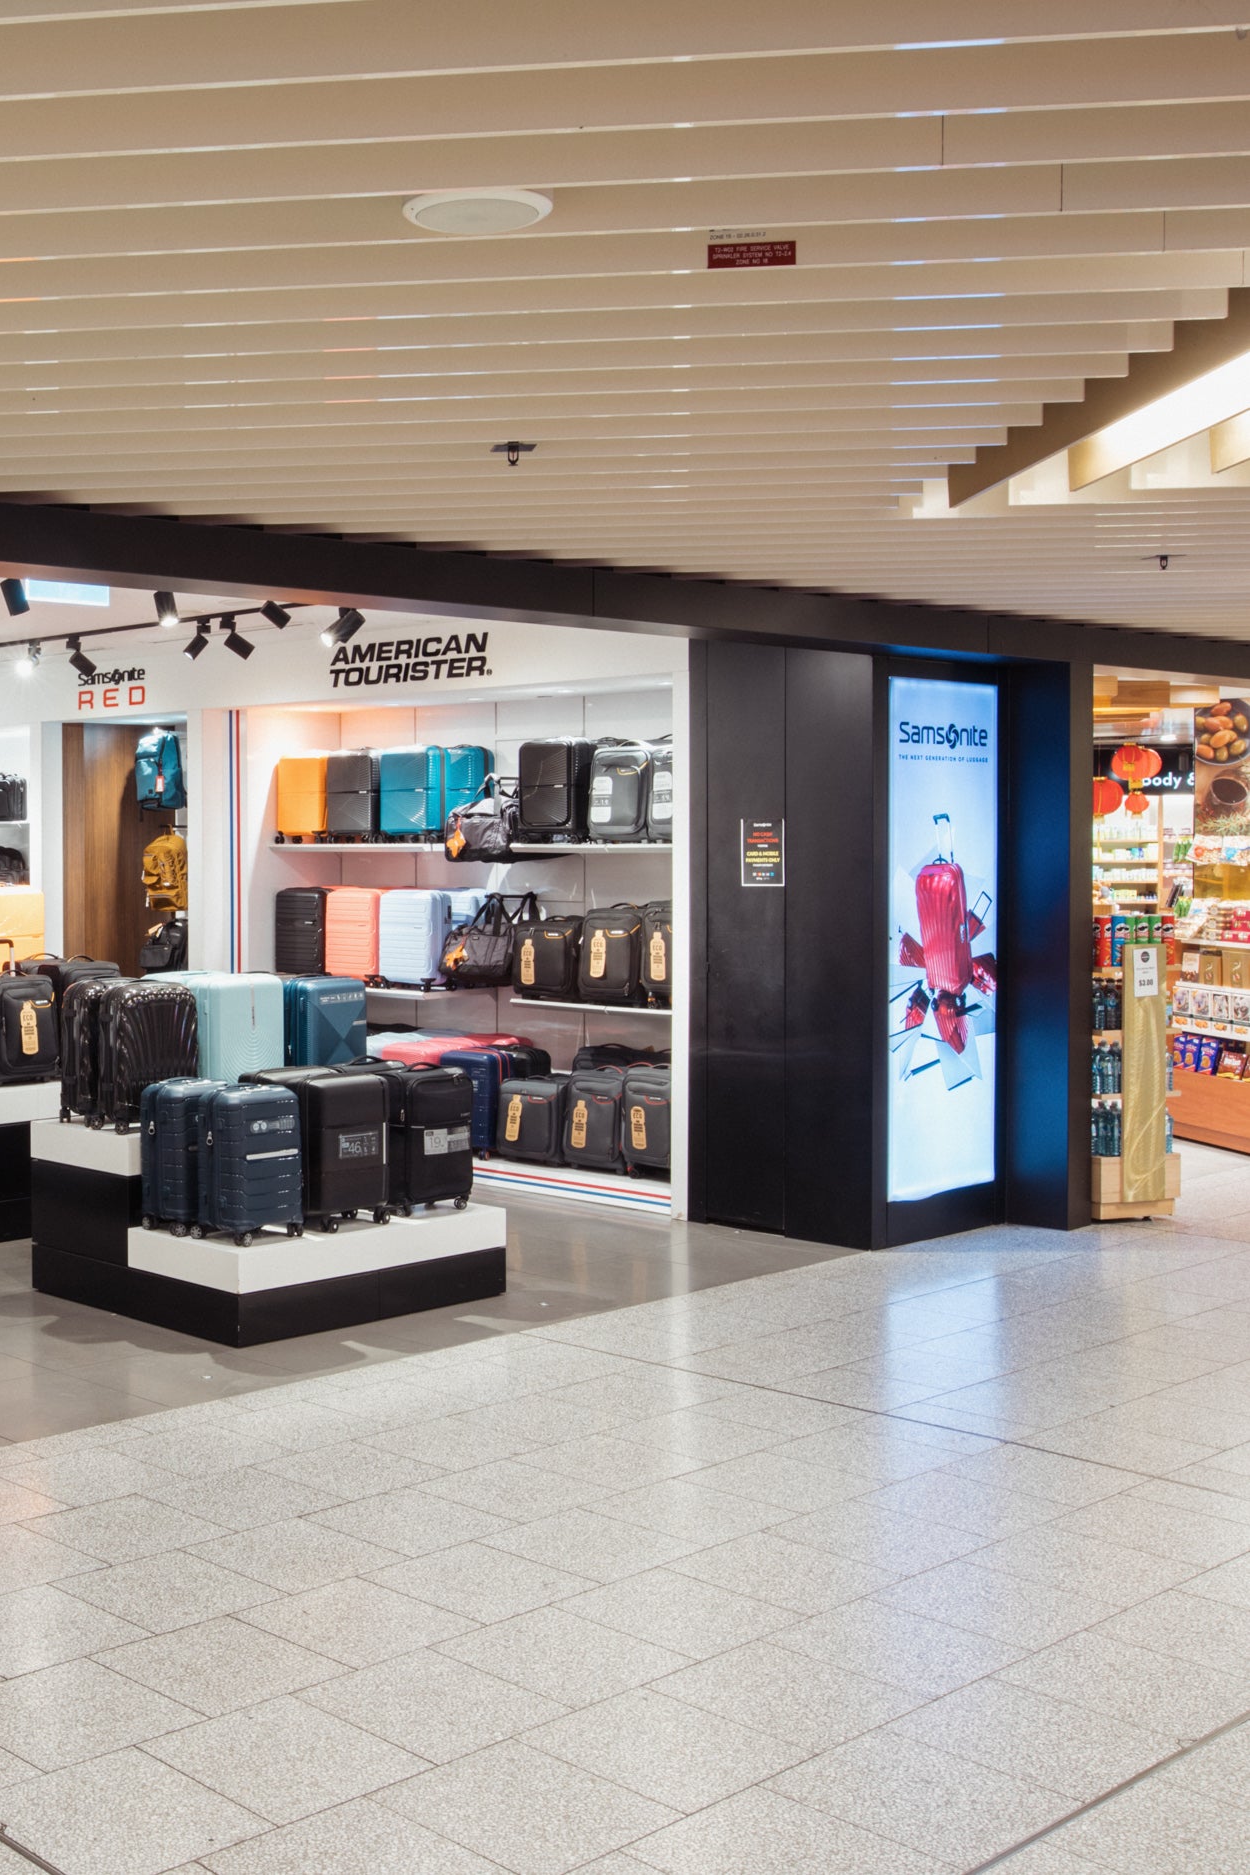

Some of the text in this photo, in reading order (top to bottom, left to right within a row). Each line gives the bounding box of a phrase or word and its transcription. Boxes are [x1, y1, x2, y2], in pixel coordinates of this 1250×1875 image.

[330, 631, 489, 666] AMERICAN
[77, 667, 146, 686] Samsonite
[77, 685, 146, 710] RED
[898, 721, 989, 749] Samsonite
